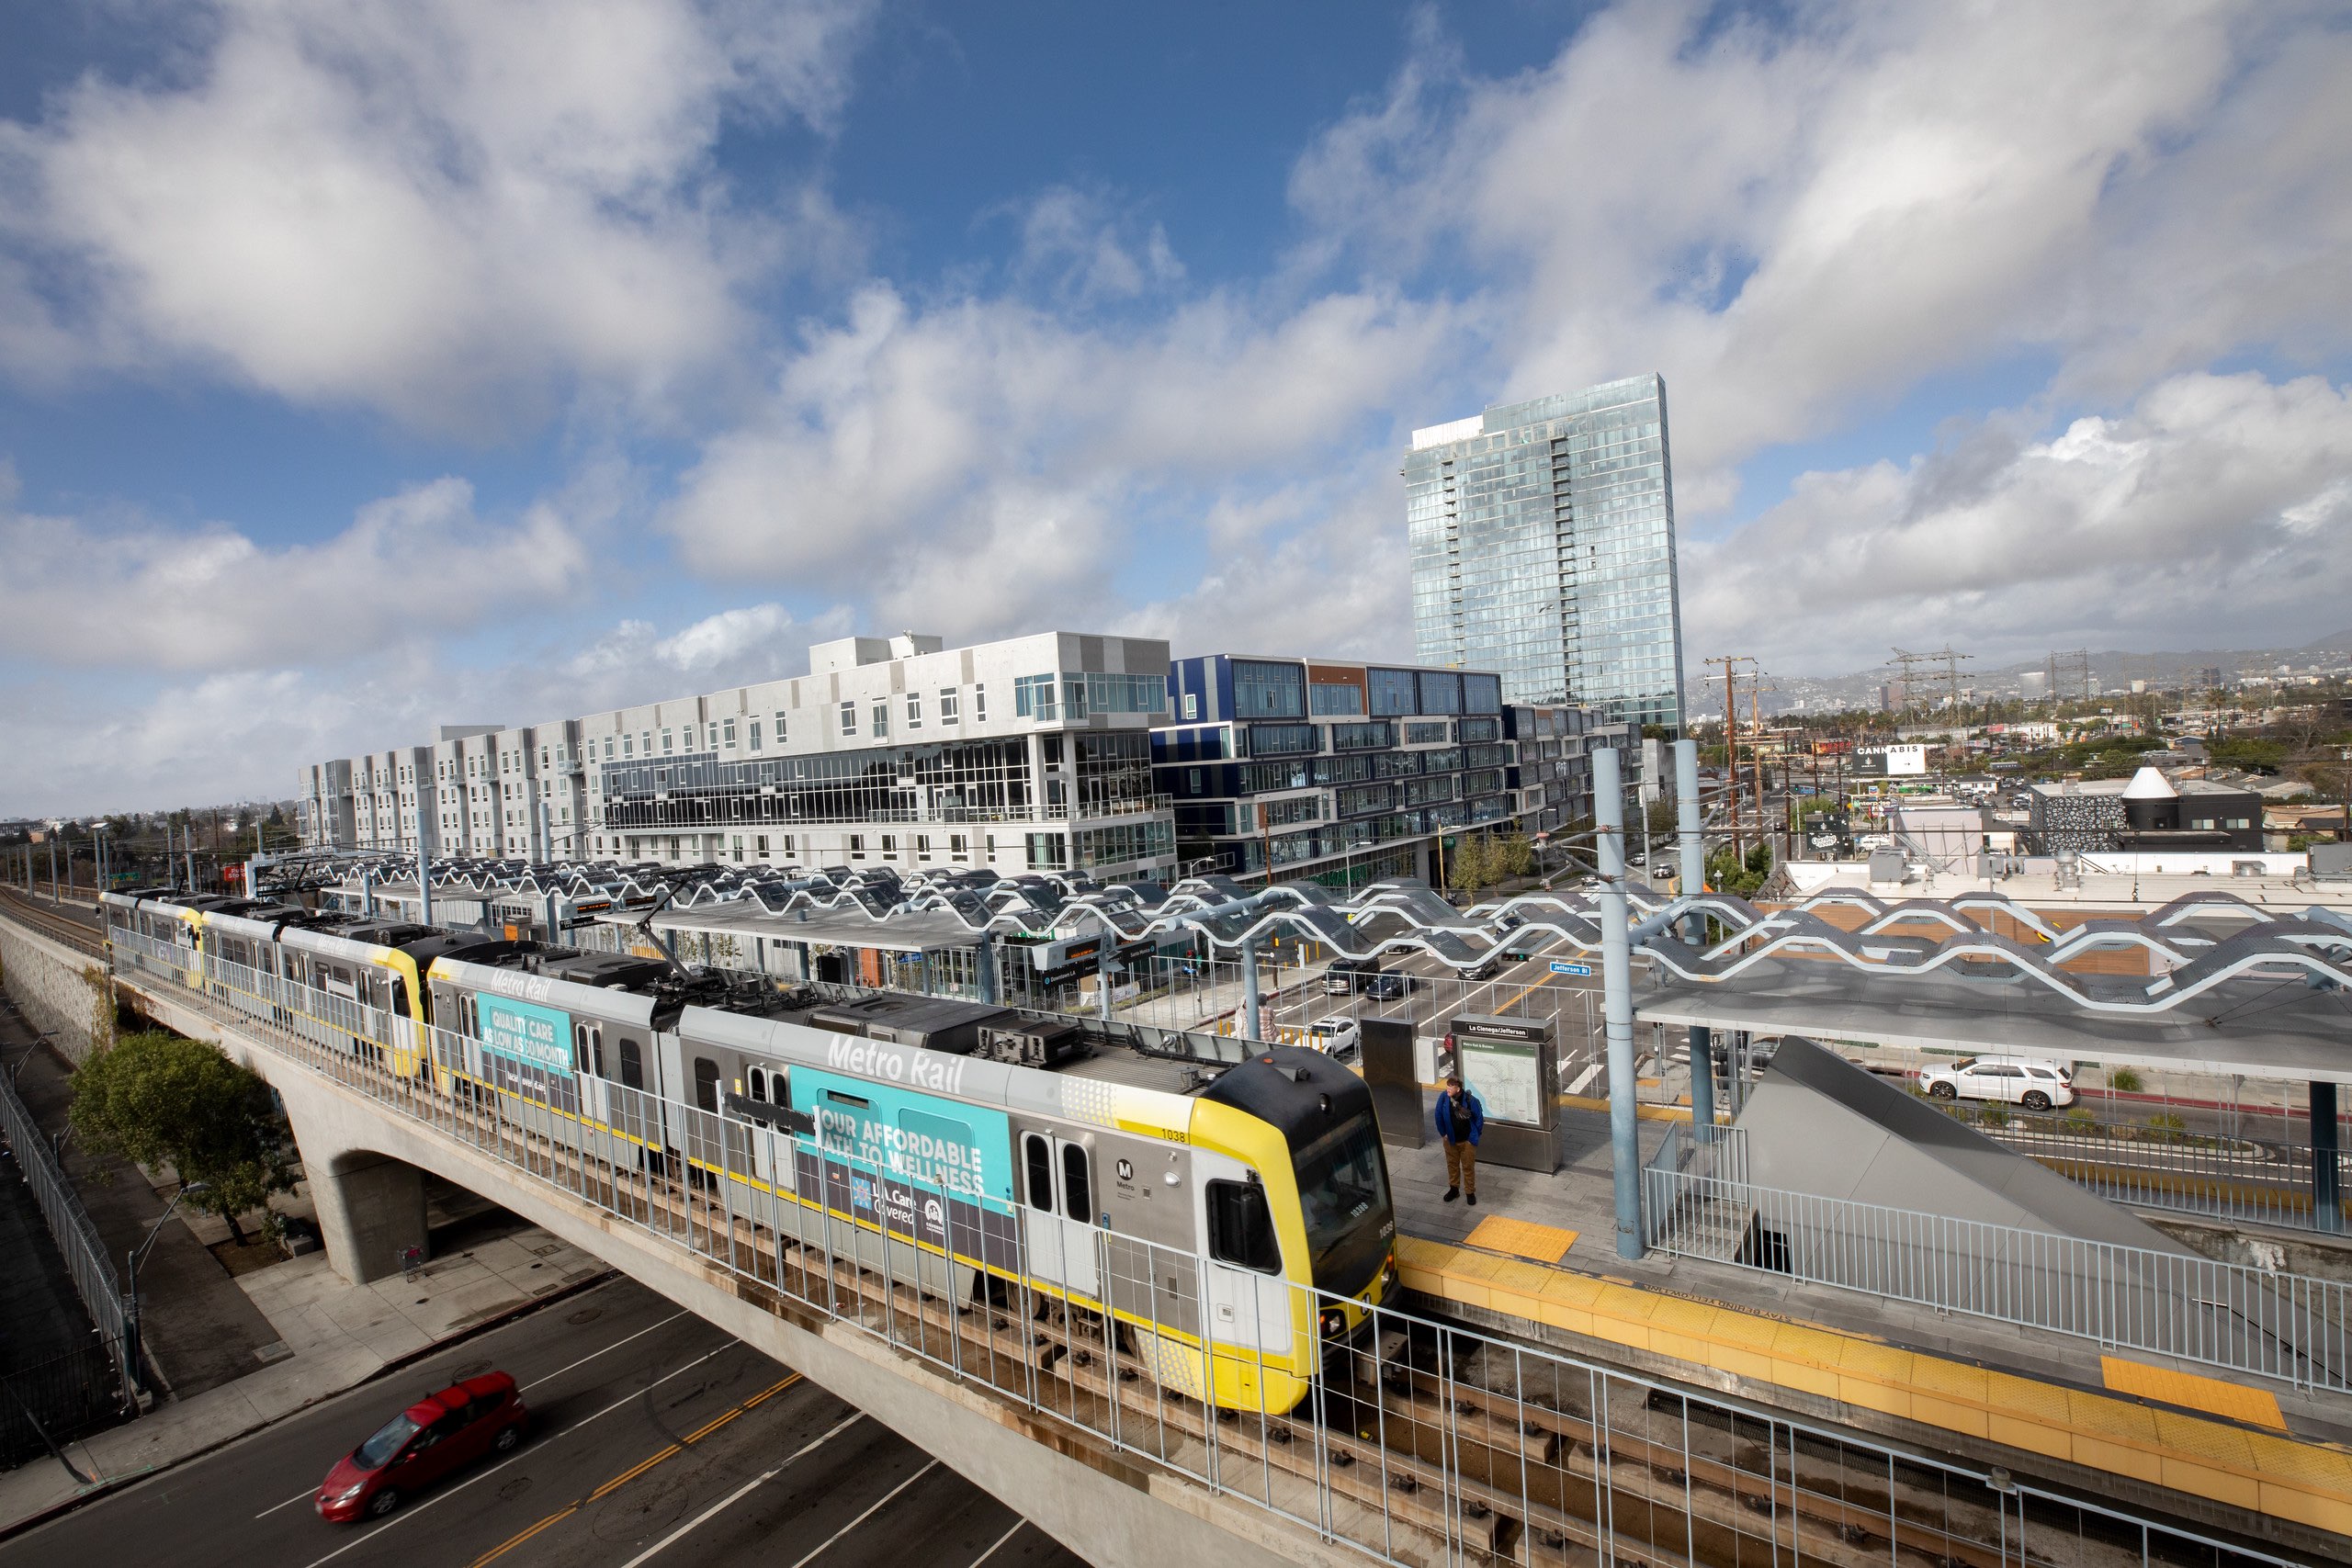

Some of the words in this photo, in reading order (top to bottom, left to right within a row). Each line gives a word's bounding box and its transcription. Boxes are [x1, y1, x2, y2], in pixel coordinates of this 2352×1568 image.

[1857, 745, 1918, 755] CANNABIS
[1554, 964, 1579, 973] Jefferson
[1051, 974, 1069, 982] Downtown
[492, 970, 525, 997] Metro
[526, 976, 551, 1002] Rail
[493, 1011, 526, 1034] QUALITY
[529, 1021, 554, 1041] CARE
[1476, 1025, 1526, 1035] Cienega/Jefferson
[483, 1027, 493, 1042] AS
[494, 1031, 513, 1047] LOW
[514, 1035, 524, 1053] AS
[828, 1033, 903, 1081] Metro
[910, 1050, 966, 1094] Rail
[1161, 1128, 1185, 1142] 1038
[862, 1120, 982, 1172] AFFORDABLE
[819, 1132, 854, 1158] ATH
[859, 1142, 883, 1166] TO
[888, 1149, 985, 1196] WELLNESS
[1116, 1180, 1135, 1191] Metro
[1669, 1290, 1714, 1305] YELLOW
[1717, 1299, 1761, 1315] BEHIND
[1764, 1312, 1792, 1323] STAY
